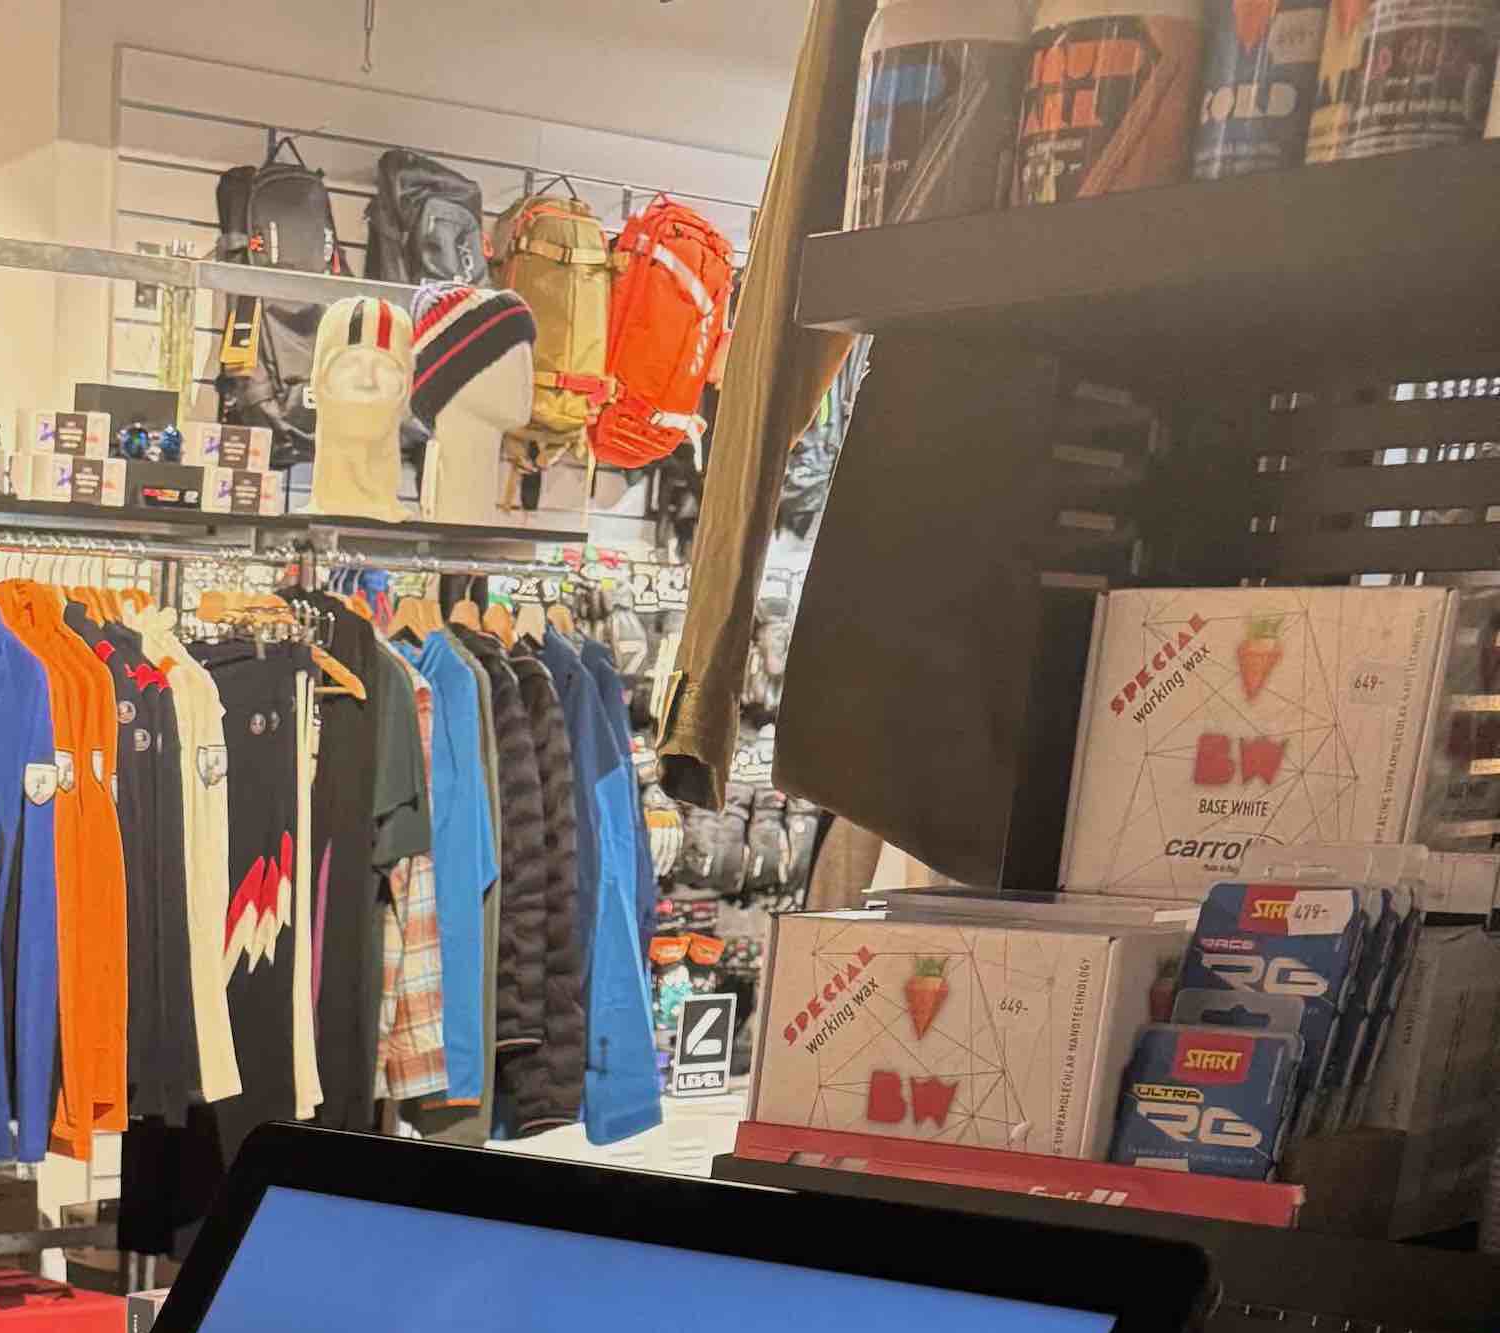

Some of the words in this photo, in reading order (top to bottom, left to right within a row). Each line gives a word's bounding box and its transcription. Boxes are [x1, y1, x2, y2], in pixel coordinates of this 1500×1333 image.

[1109, 611, 1209, 718] SPECIAL
[1132, 669, 1186, 726] working
[1183, 642, 1212, 673] wax
[1193, 732, 1289, 786] BW
[1198, 798, 1229, 816] BASE
[1231, 799, 1269, 818] WHITE
[782, 944, 877, 1048] SPECIAL
[805, 1004, 857, 1057] working
[852, 975, 881, 1008] wax
[1185, 1048, 1244, 1072] START
[866, 1069, 960, 1129] BW
[1136, 1085, 1201, 1101] ULTRA
